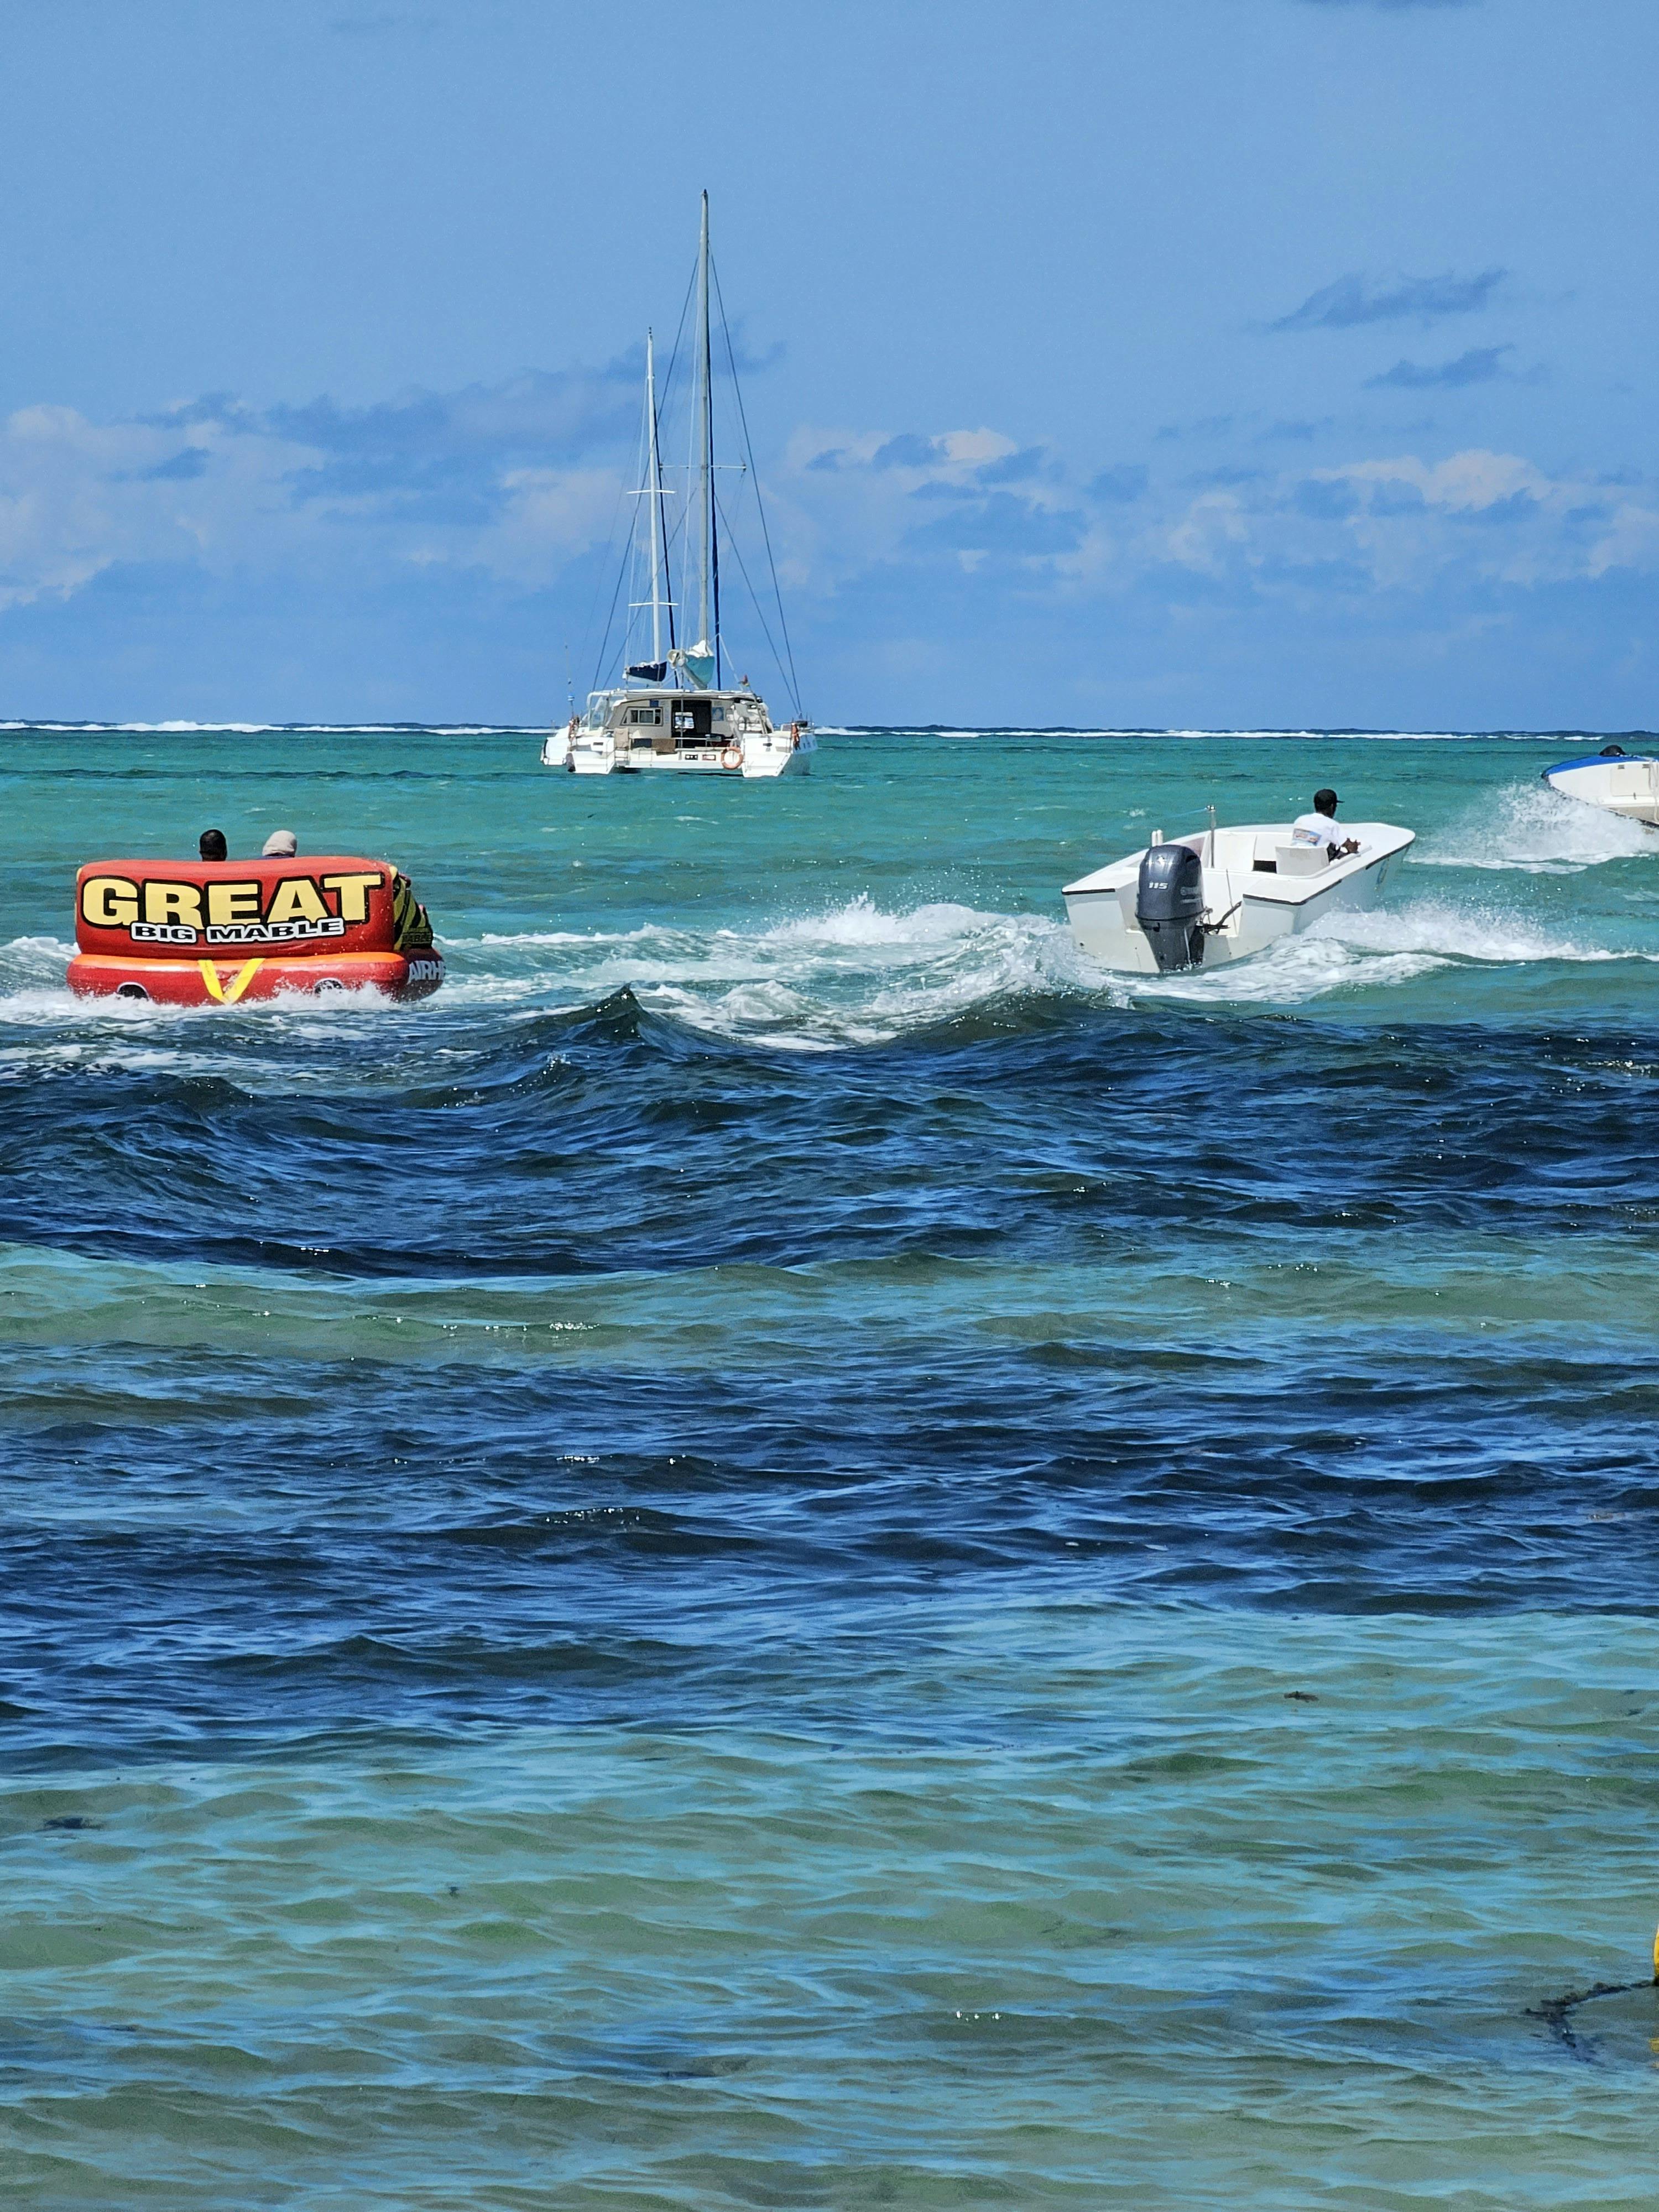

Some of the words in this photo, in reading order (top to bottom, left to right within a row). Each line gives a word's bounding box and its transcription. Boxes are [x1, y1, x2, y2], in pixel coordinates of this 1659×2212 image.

[82, 874, 382, 929] GREAT
[134, 925, 195, 941] BIG
[210, 920, 342, 941] MABLE
